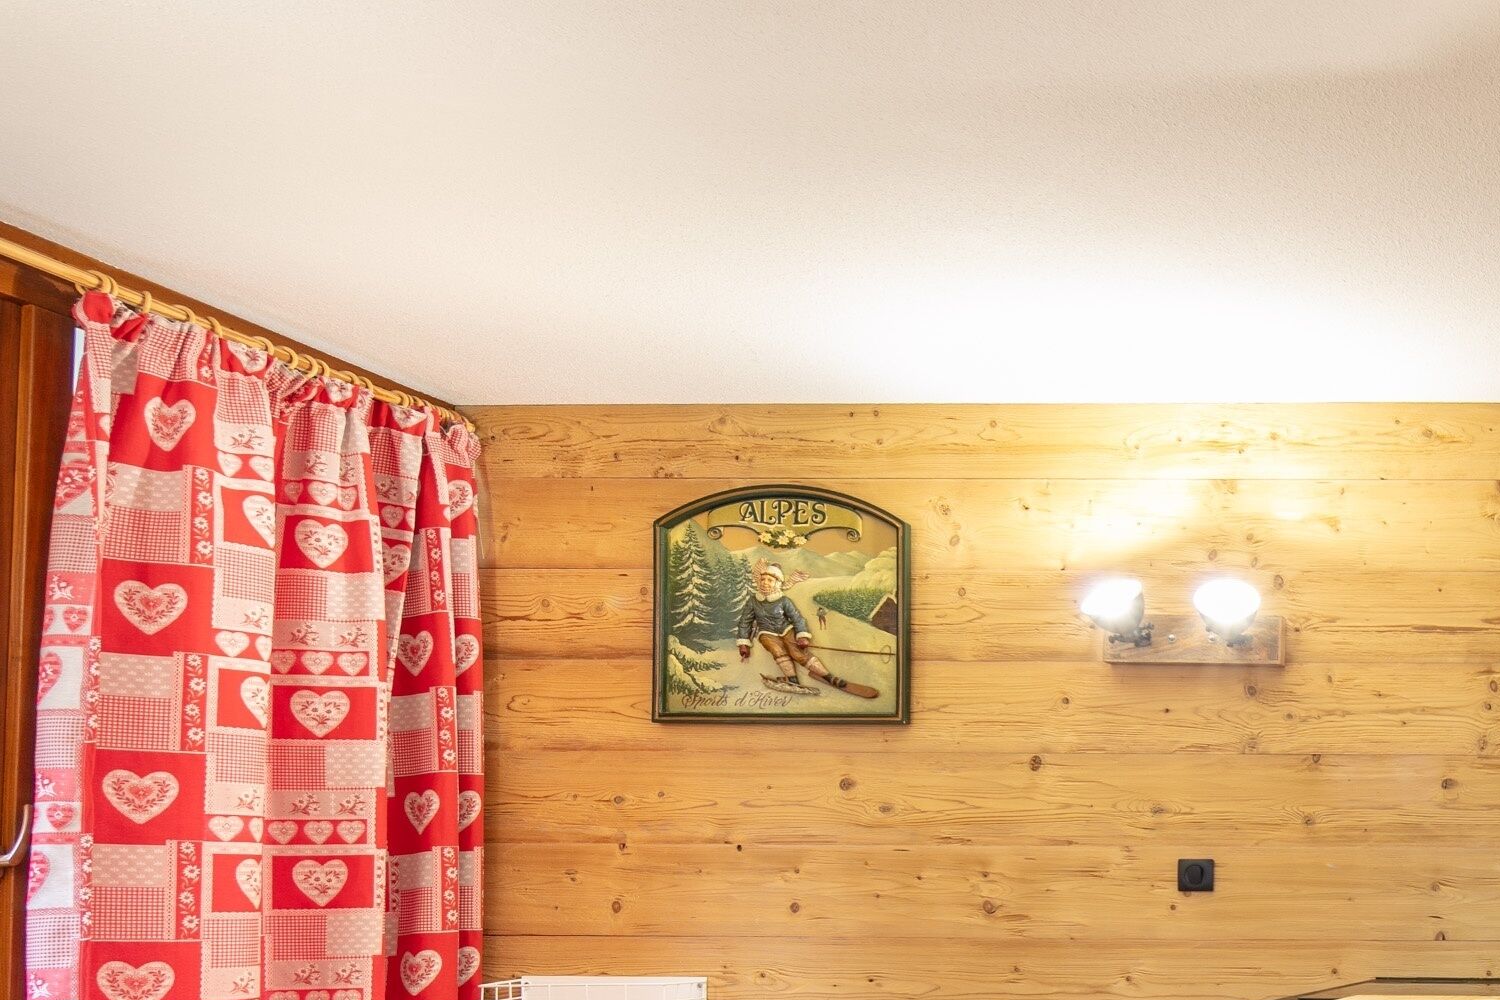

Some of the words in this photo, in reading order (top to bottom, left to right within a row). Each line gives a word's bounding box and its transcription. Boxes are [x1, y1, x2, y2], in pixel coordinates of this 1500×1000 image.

[739, 499, 827, 526] ALPES
[681, 689, 728, 709] Sports
[734, 690, 793, 710] d'Hiver
